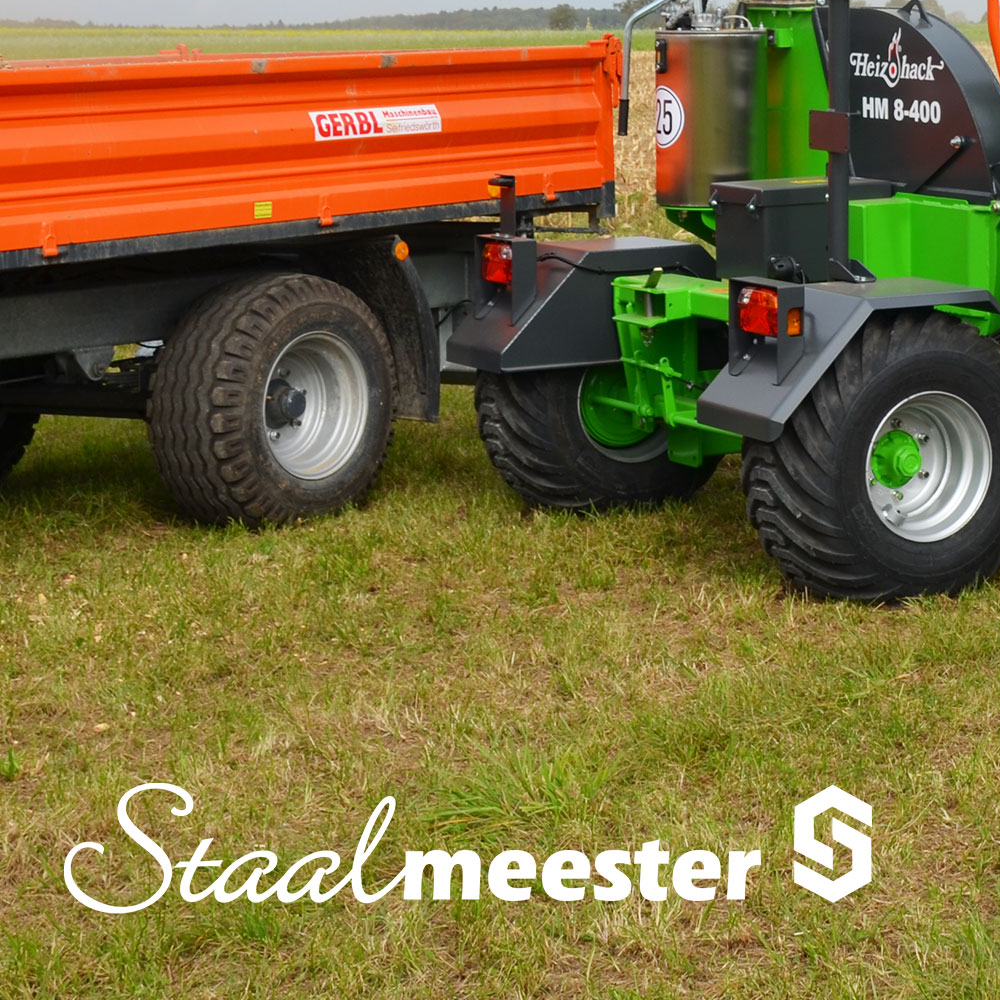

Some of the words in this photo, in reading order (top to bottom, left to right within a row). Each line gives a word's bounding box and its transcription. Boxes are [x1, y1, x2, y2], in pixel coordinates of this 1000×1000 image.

[382, 108, 437, 118] Maschinenbau
[862, 96, 889, 120] HM
[893, 98, 941, 124] 8-400
[315, 111, 383, 138] GERBL
